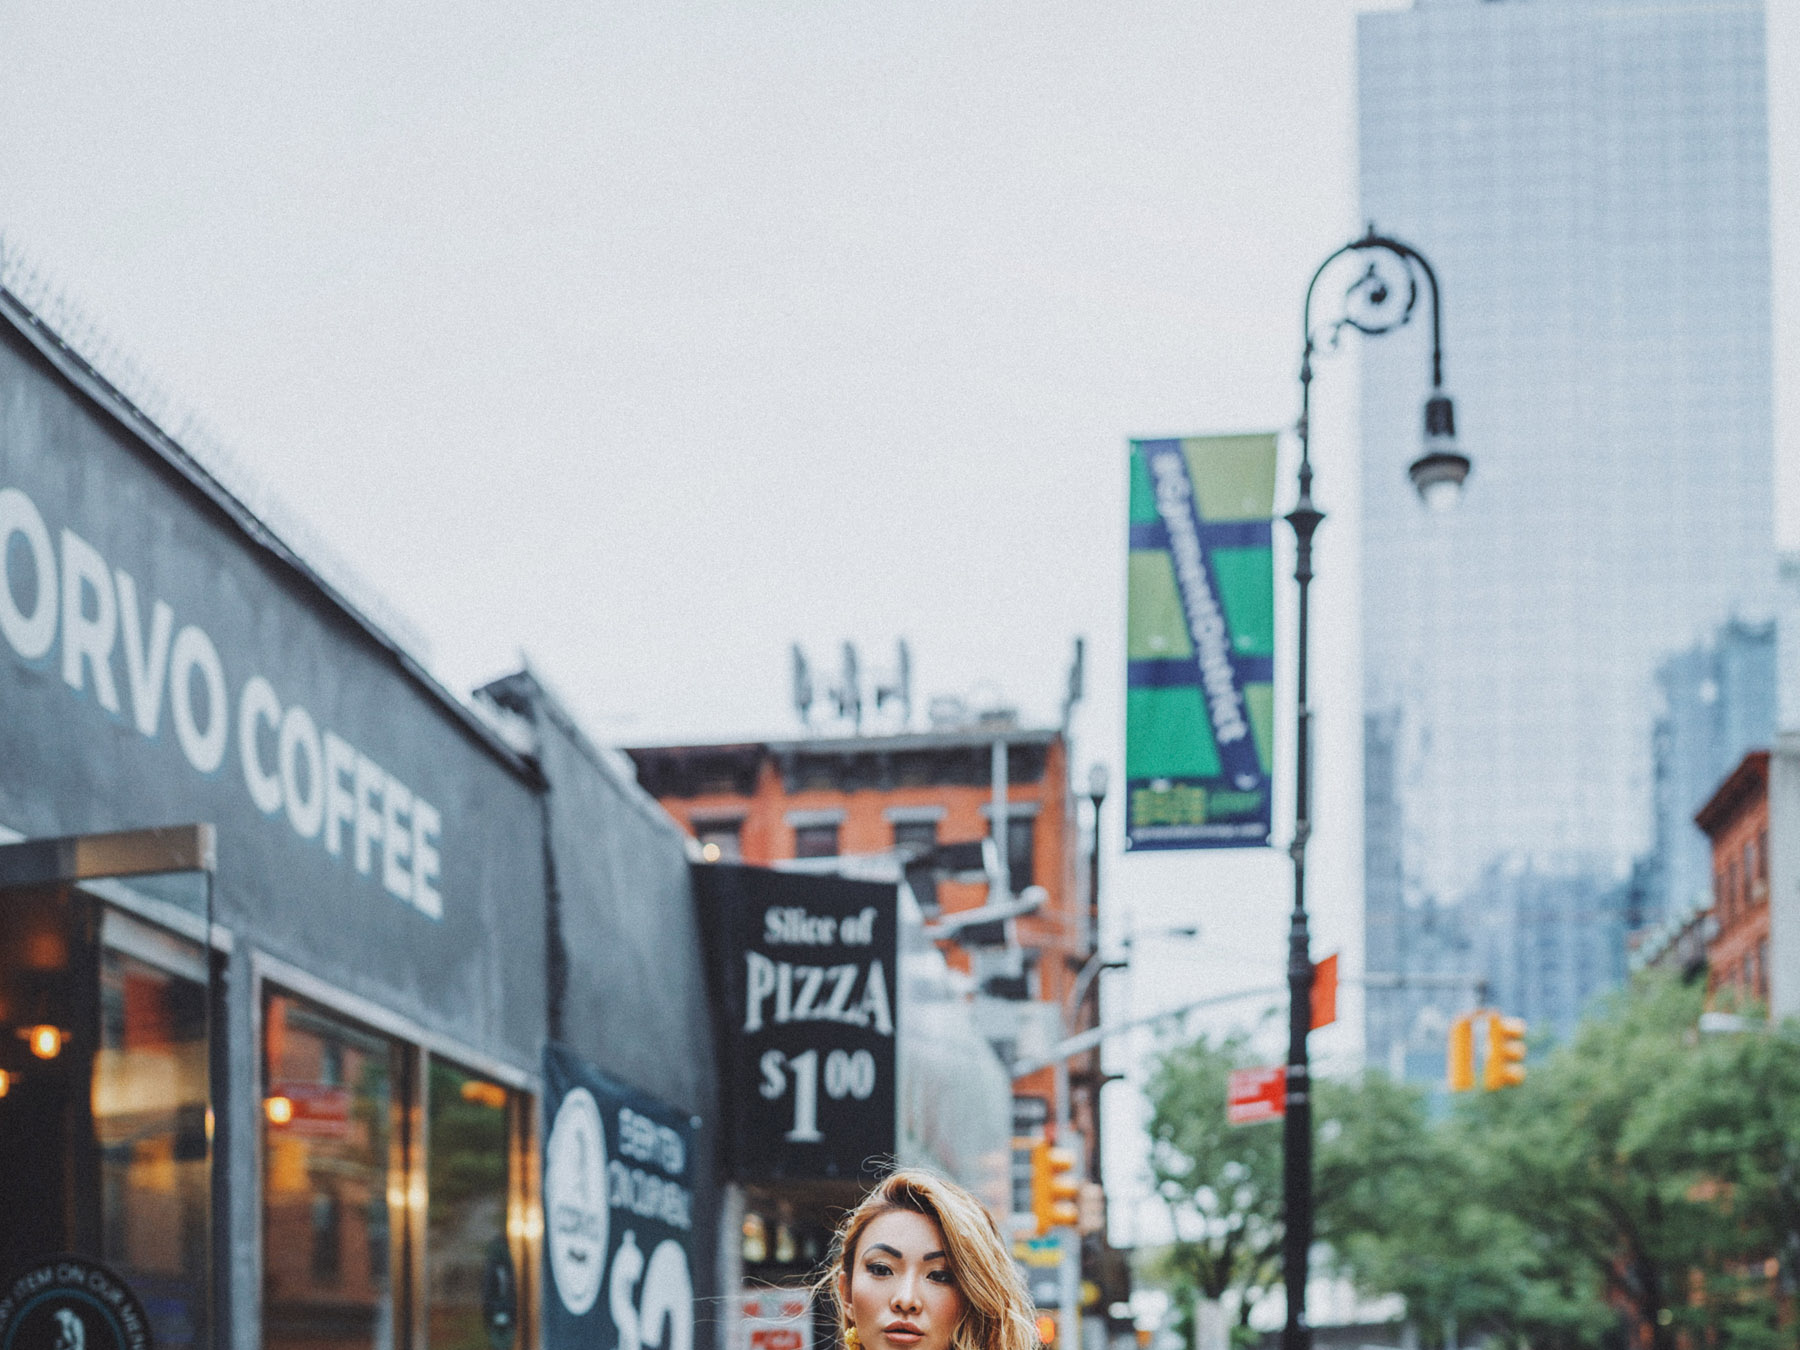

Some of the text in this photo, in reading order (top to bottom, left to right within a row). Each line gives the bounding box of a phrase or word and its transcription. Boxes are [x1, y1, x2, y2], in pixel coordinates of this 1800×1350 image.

[0, 486, 443, 921] ORVO COFFEE
[764, 907, 877, 945] Slice of
[744, 950, 894, 1036] PIZZA
[56, 1263, 85, 1283] ON
